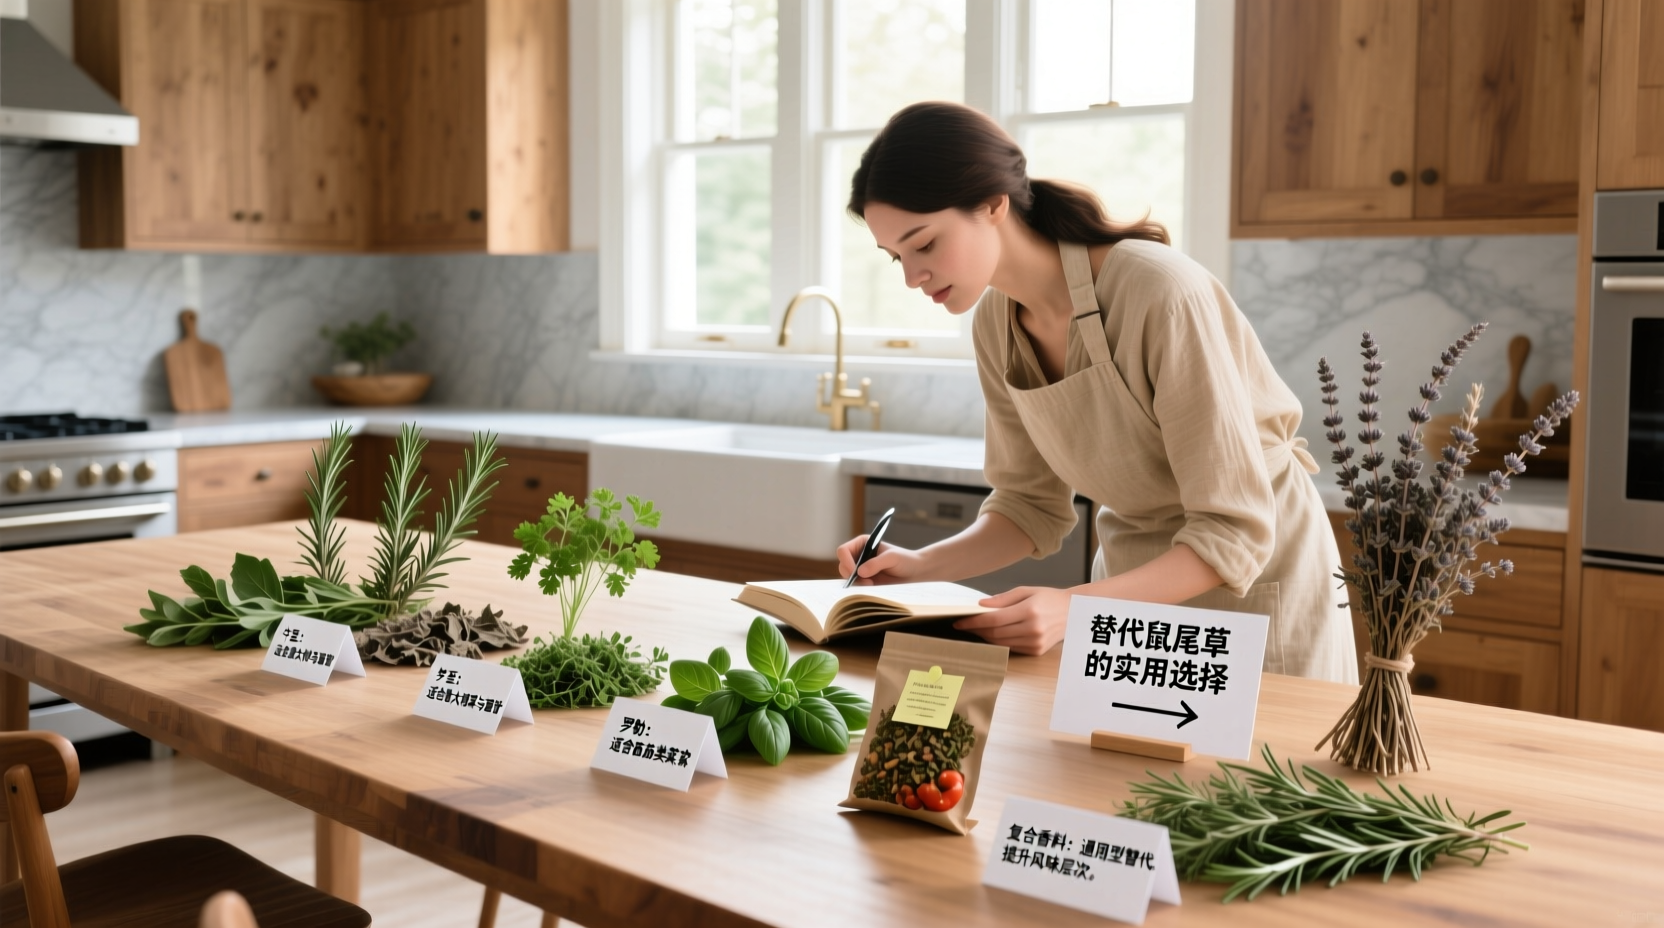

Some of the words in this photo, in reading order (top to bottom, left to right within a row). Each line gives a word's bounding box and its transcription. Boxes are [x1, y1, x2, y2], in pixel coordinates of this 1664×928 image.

[1090, 613, 1232, 659] 替代鼠尾草
[1084, 649, 1229, 696] 的实用选择
